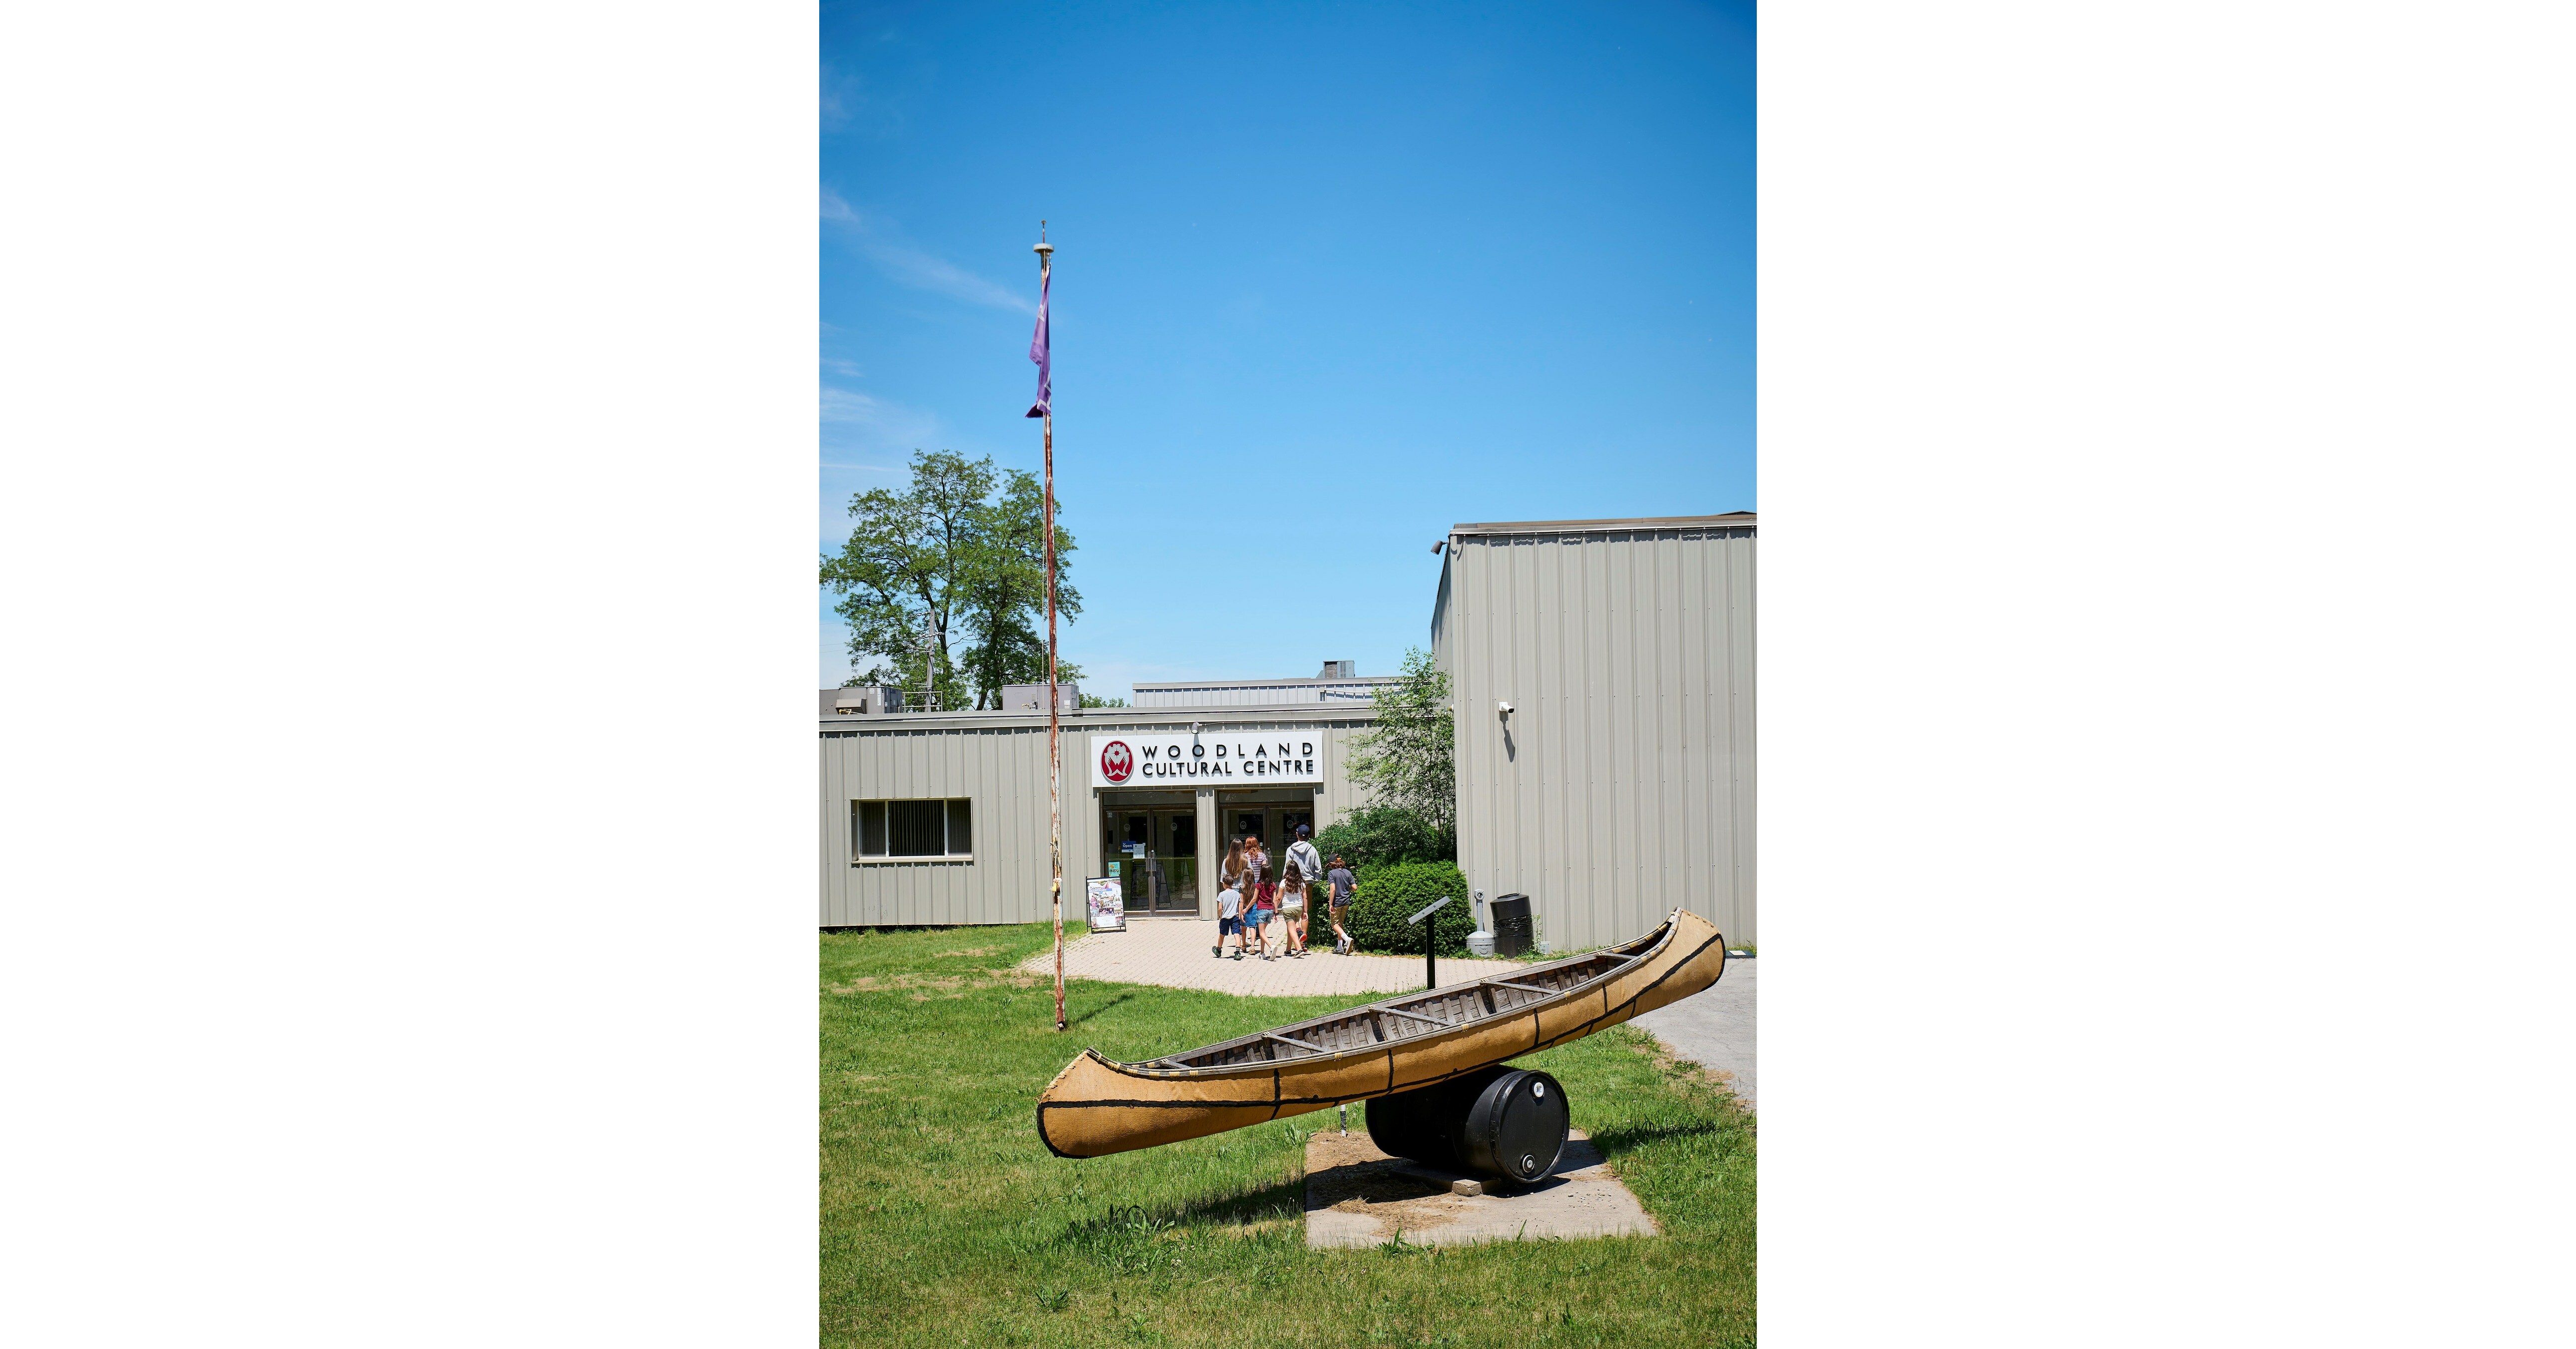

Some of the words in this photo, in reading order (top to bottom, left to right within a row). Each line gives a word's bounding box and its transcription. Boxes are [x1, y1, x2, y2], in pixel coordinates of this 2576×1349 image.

[1142, 742, 1313, 758] WOODLAND
[1142, 761, 1232, 776] CULTURAL
[1243, 759, 1314, 773] CENTRE
